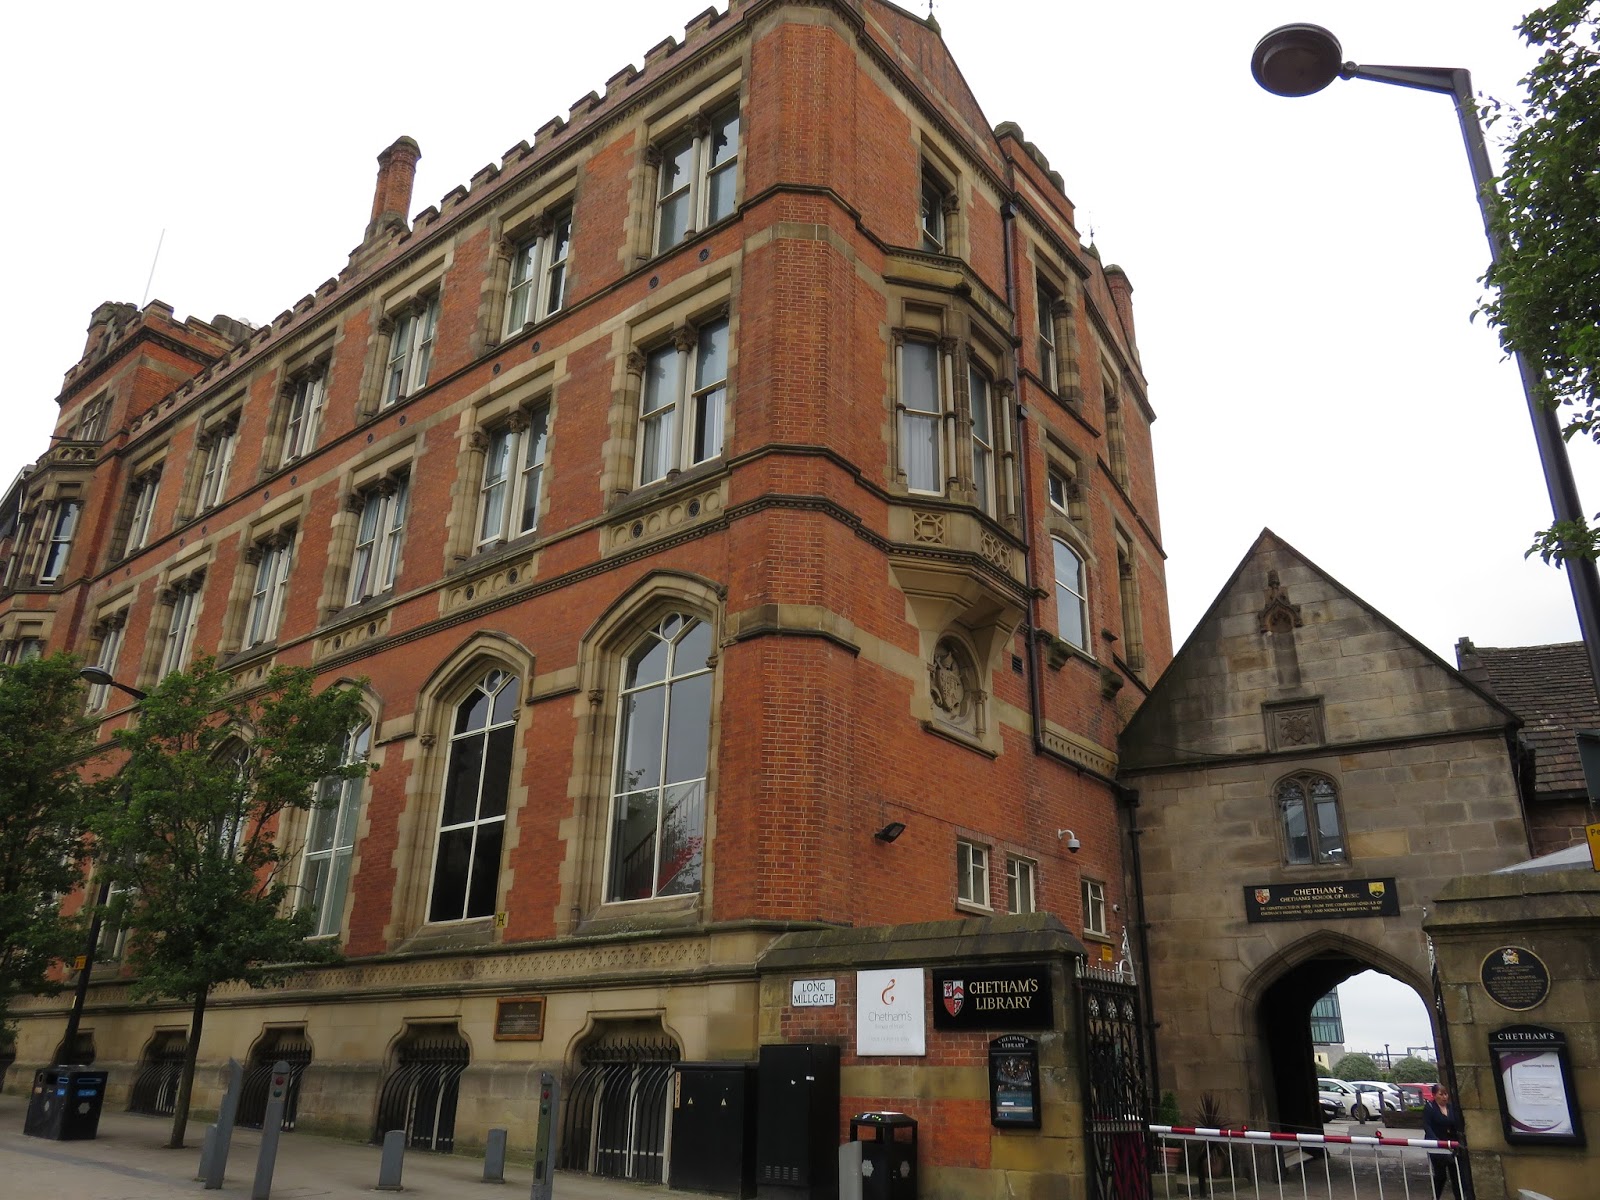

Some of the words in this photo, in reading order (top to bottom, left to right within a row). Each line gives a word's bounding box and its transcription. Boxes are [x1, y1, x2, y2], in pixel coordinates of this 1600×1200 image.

[1293, 886, 1344, 896] CHETHAM'S
[802, 982, 826, 992] LONG
[969, 978, 1038, 994] CHETHAM'S
[793, 993, 834, 1004] MILLGATE
[975, 996, 1032, 1010] LIBRARY
[868, 1010, 912, 1022] Chetham's
[1497, 1032, 1555, 1041] CHETHAM'S
